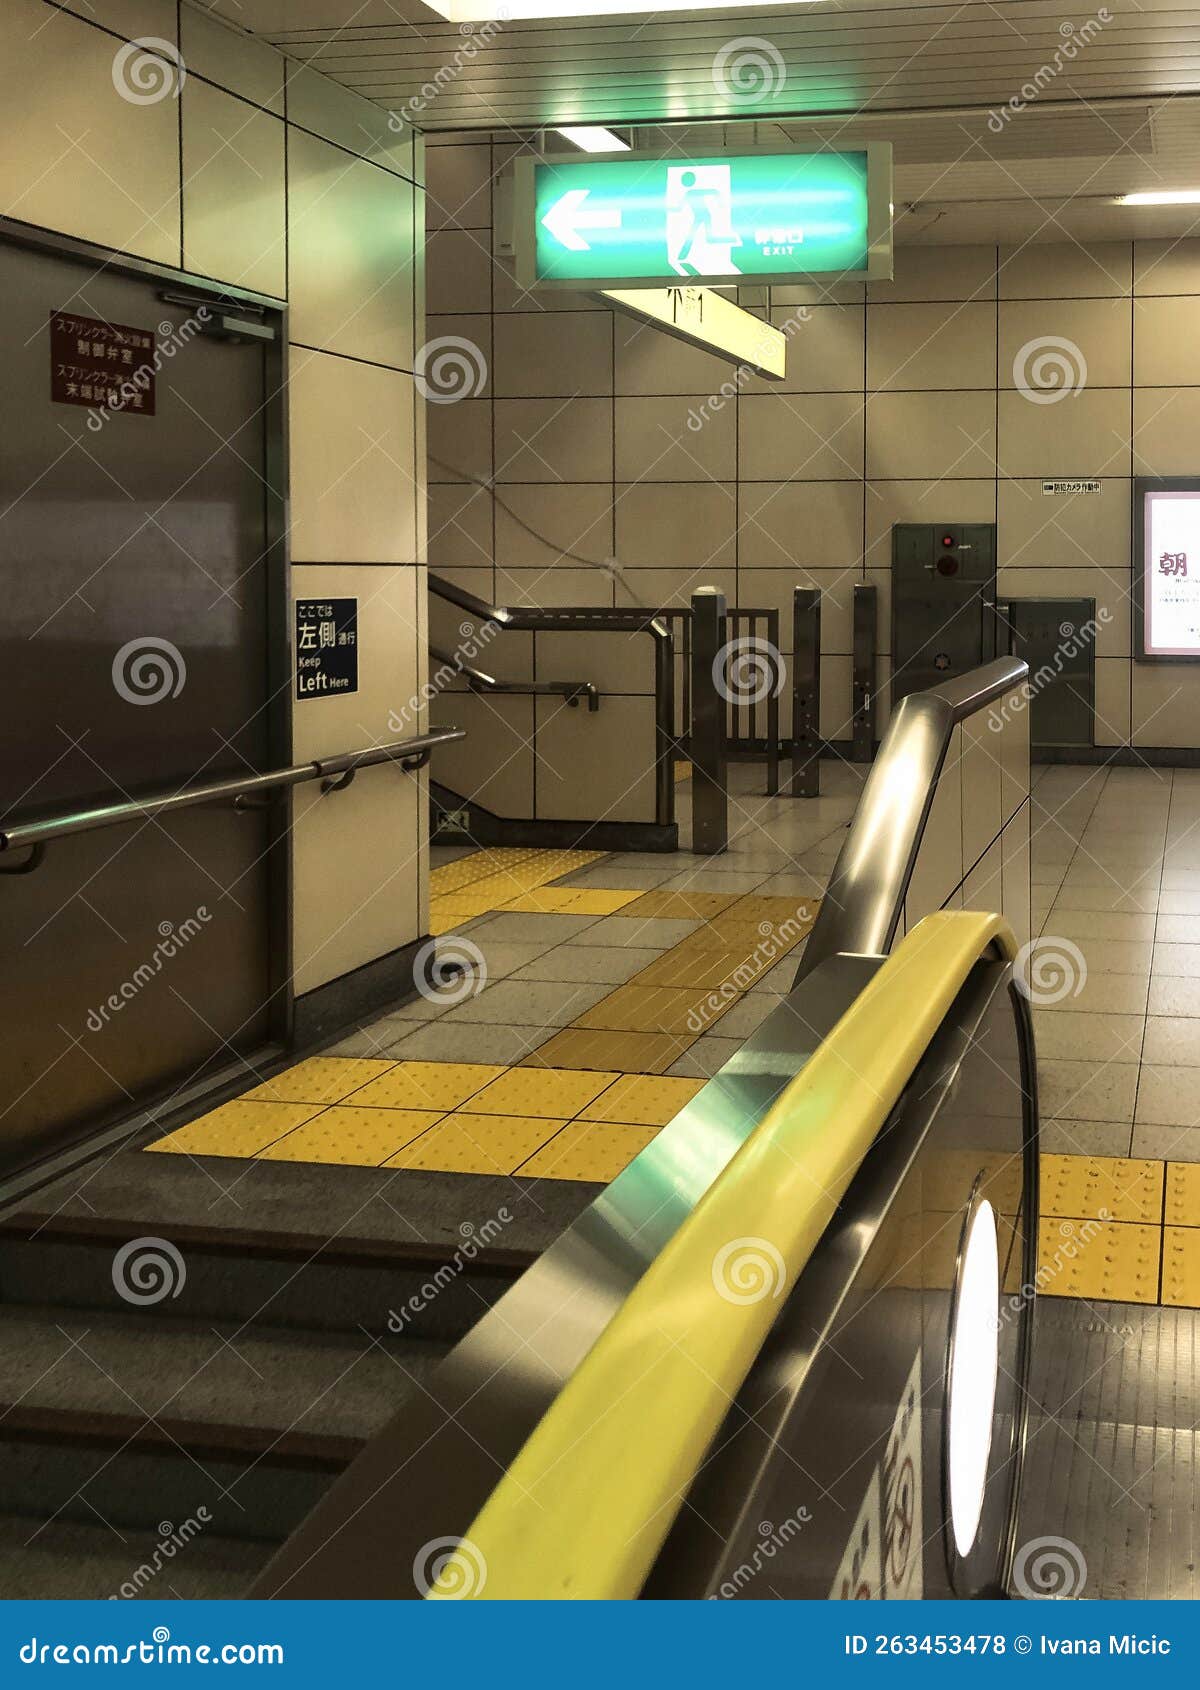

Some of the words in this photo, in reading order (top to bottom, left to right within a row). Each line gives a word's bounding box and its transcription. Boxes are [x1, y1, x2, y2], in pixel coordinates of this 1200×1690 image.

[763, 246, 793, 256] EXIT
[1159, 552, 1188, 576] 朝
[299, 605, 333, 618] ここでは
[299, 657, 321, 669] Keep
[300, 672, 327, 692] Left
[329, 678, 349, 688] Here
